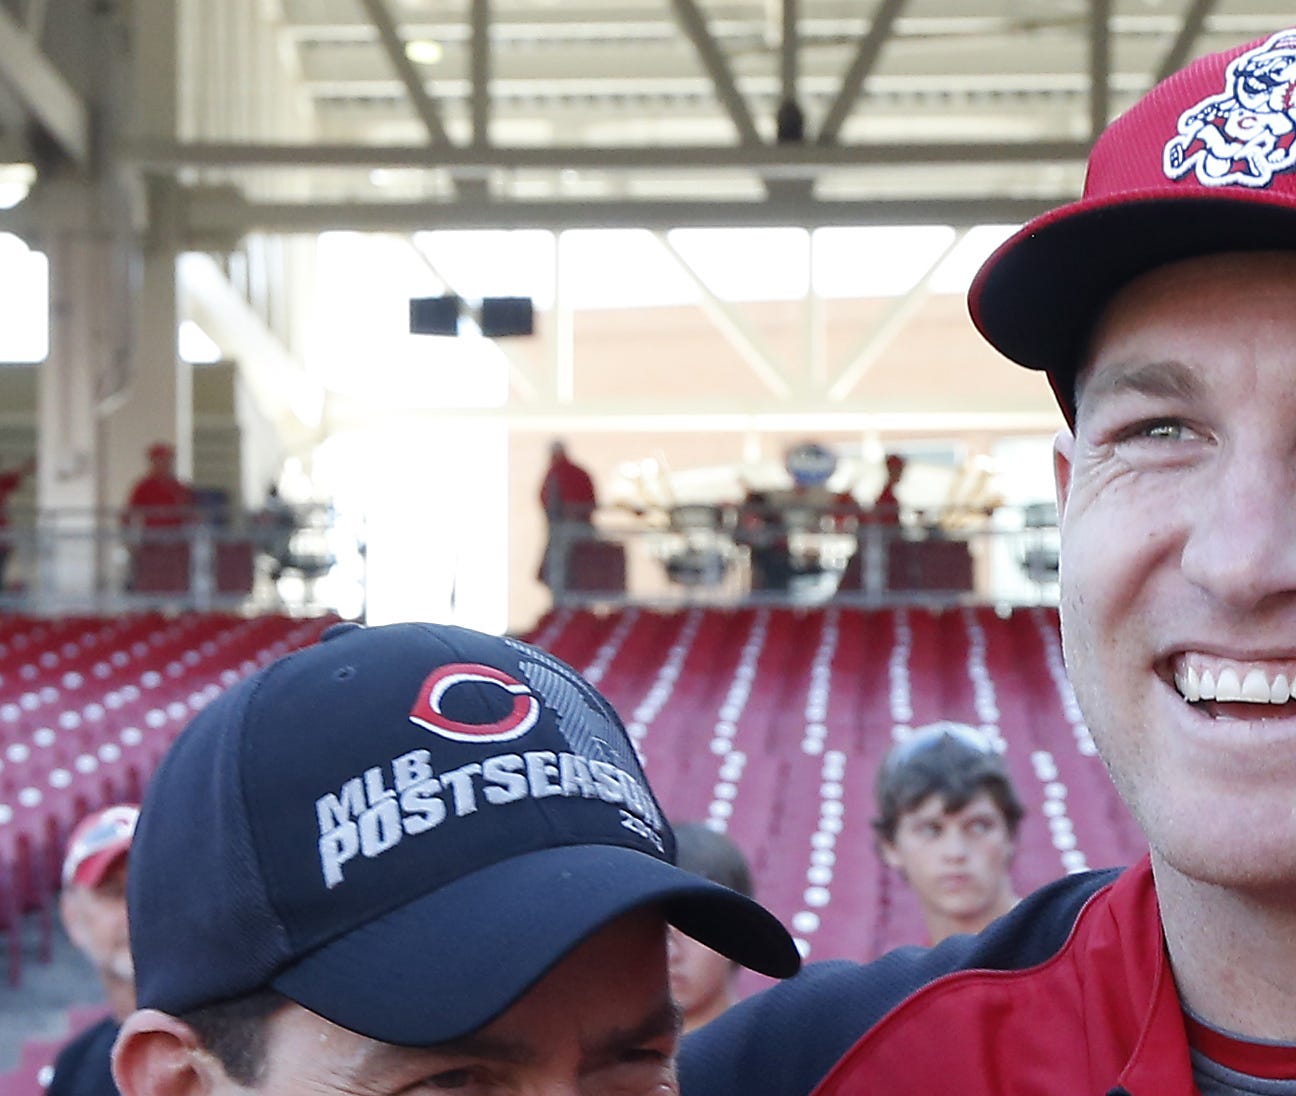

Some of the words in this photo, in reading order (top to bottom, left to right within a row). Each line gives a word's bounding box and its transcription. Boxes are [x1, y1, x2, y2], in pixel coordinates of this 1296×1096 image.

[410, 663, 540, 742] C
[315, 749, 433, 836] MLB
[318, 750, 663, 890] POSTSEASON
